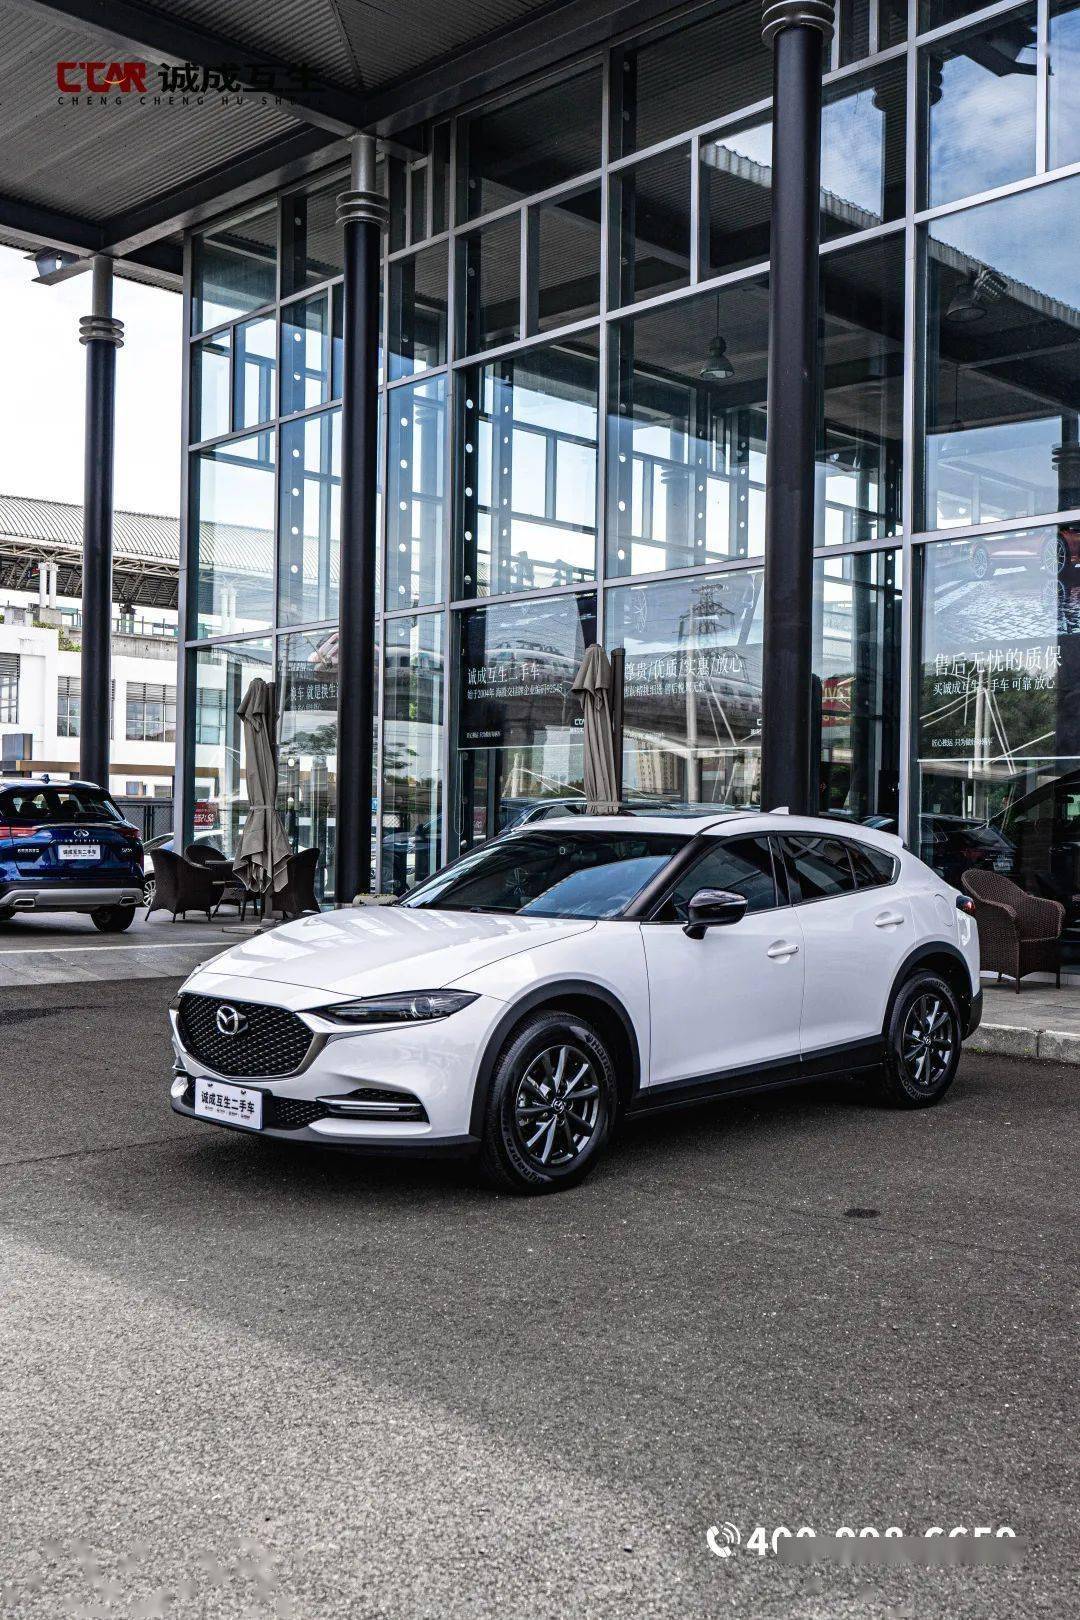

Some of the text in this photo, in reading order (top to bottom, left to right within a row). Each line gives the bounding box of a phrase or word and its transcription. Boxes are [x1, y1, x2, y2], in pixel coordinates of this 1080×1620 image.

[935, 645, 1062, 677] 售后无忧的质保
[468, 663, 540, 685] 诚成互生二手车
[1012, 676, 1032, 692] 可靠
[1034, 674, 1056, 690] 放心
[201, 1090, 255, 1114] 诚成互生二手车
